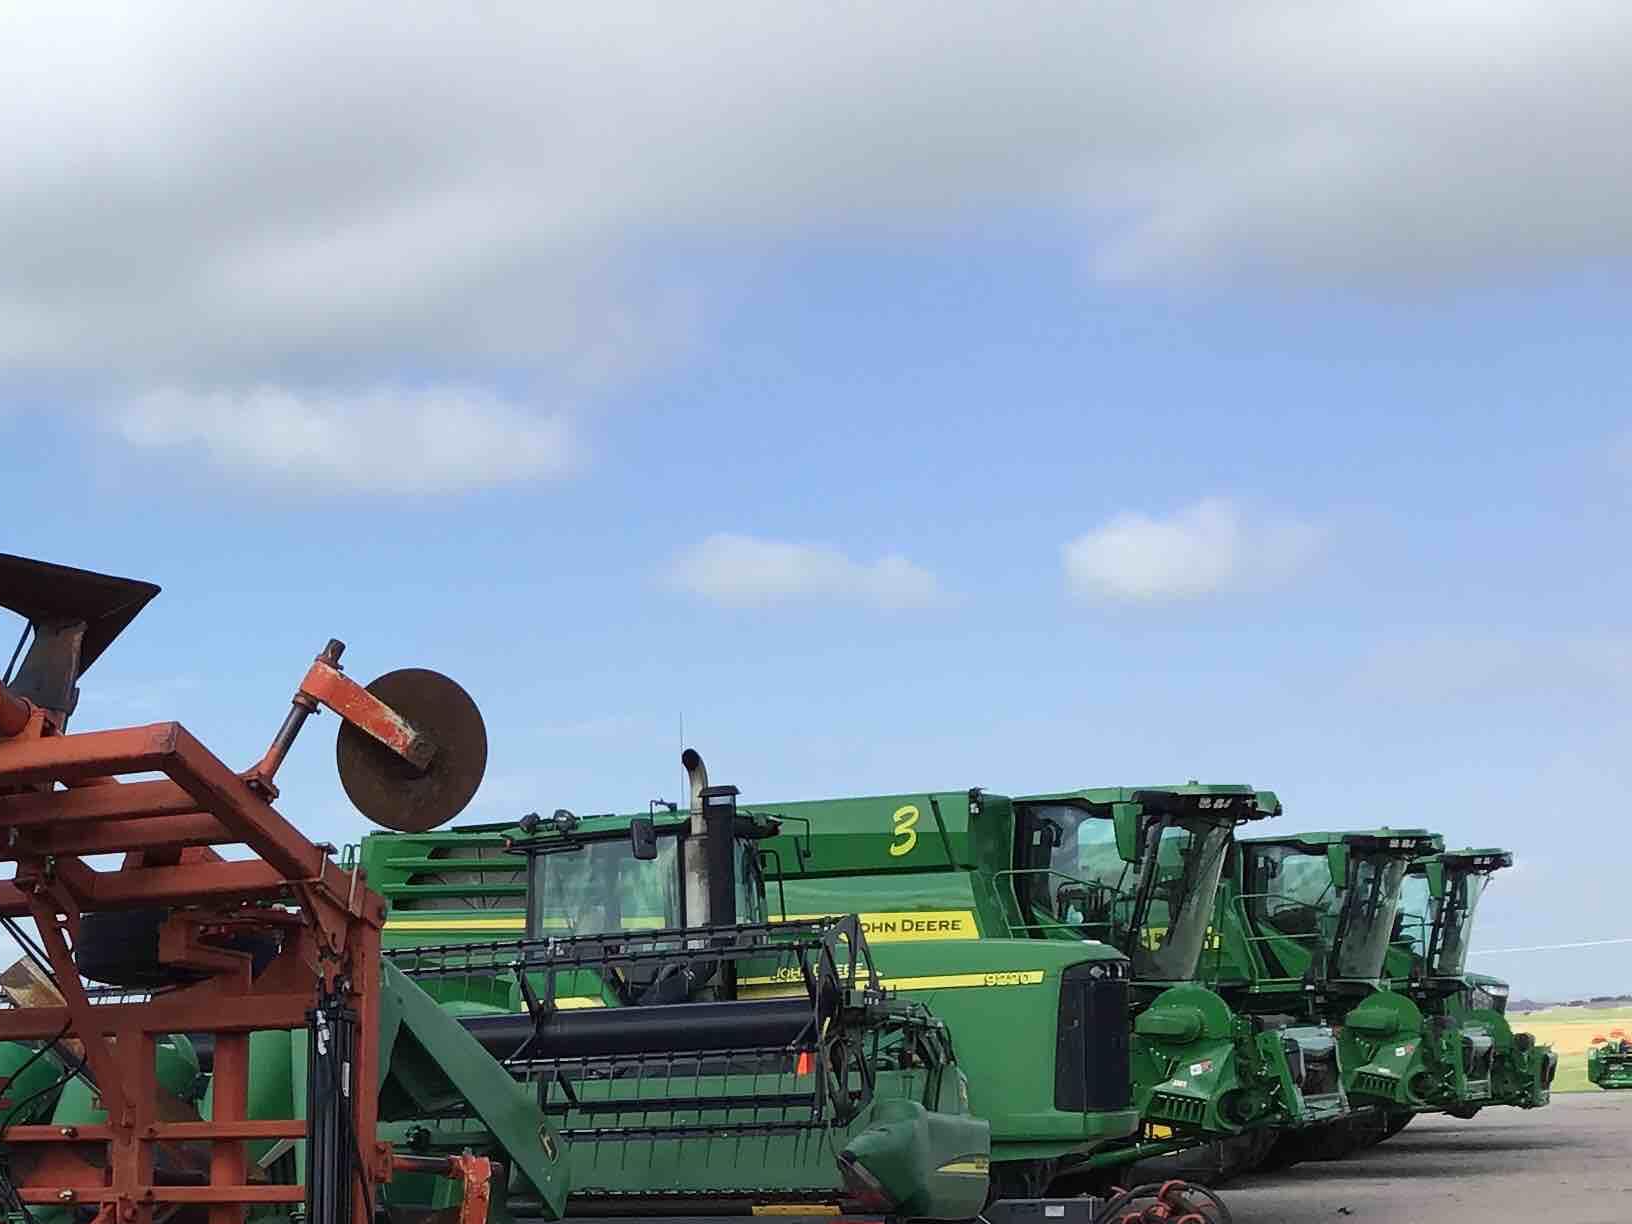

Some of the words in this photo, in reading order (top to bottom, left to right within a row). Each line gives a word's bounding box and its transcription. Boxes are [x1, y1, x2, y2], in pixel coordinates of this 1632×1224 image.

[890, 804, 919, 856] 3
[858, 922, 896, 933] OHN
[901, 919, 962, 932] DEERE
